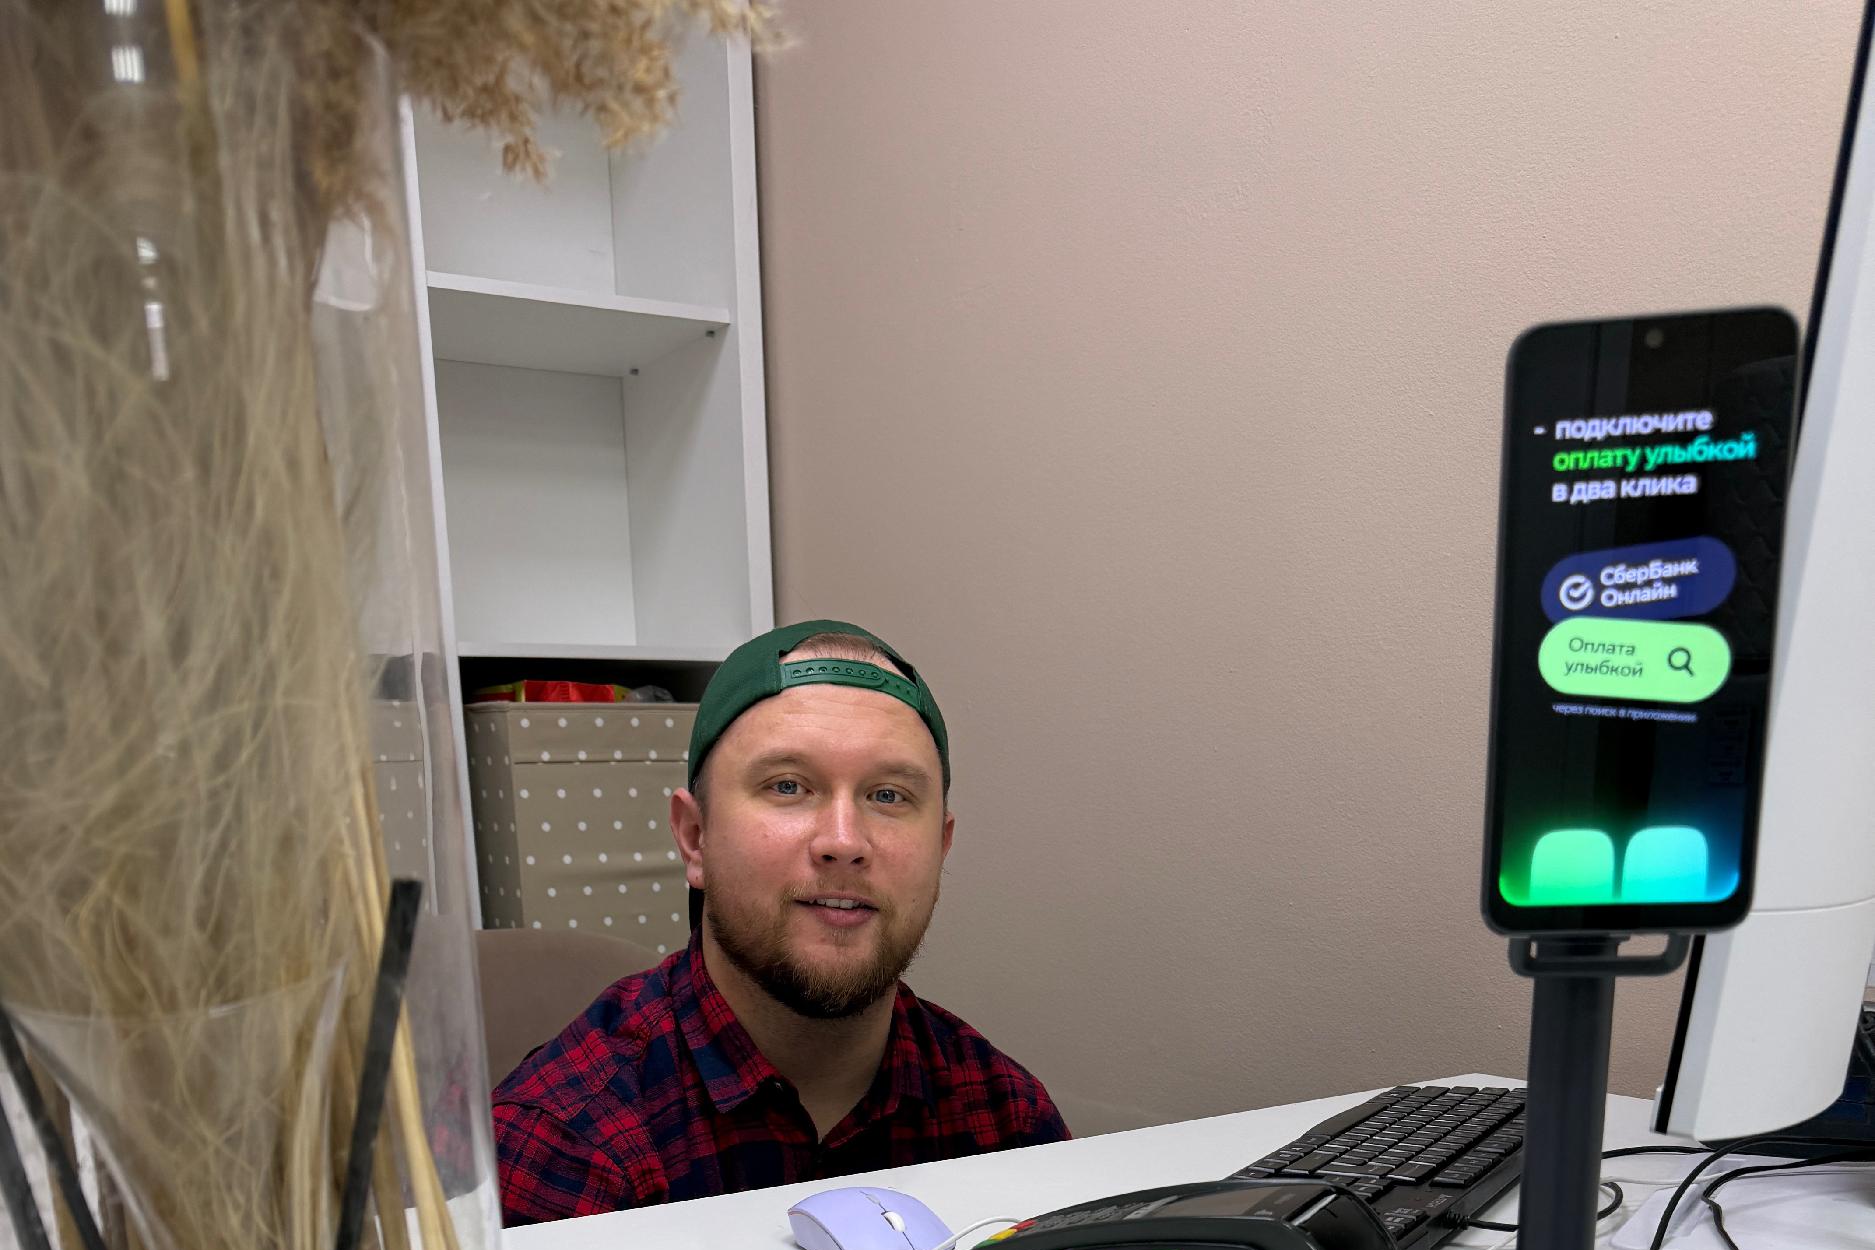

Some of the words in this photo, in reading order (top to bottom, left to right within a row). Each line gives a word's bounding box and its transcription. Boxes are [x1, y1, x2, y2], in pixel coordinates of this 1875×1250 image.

[1555, 411, 1713, 441] подключите
[1552, 447, 1640, 472] оплату
[1643, 432, 1756, 471] улыбкой
[1552, 483, 1567, 501] в
[1569, 480, 1617, 504] два
[1620, 474, 1697, 498] клика
[1600, 559, 1698, 586] СберБанк
[1600, 581, 1678, 607] Онлайн
[1568, 637, 1636, 656] Оплата
[1564, 660, 1643, 677] улыбкой
